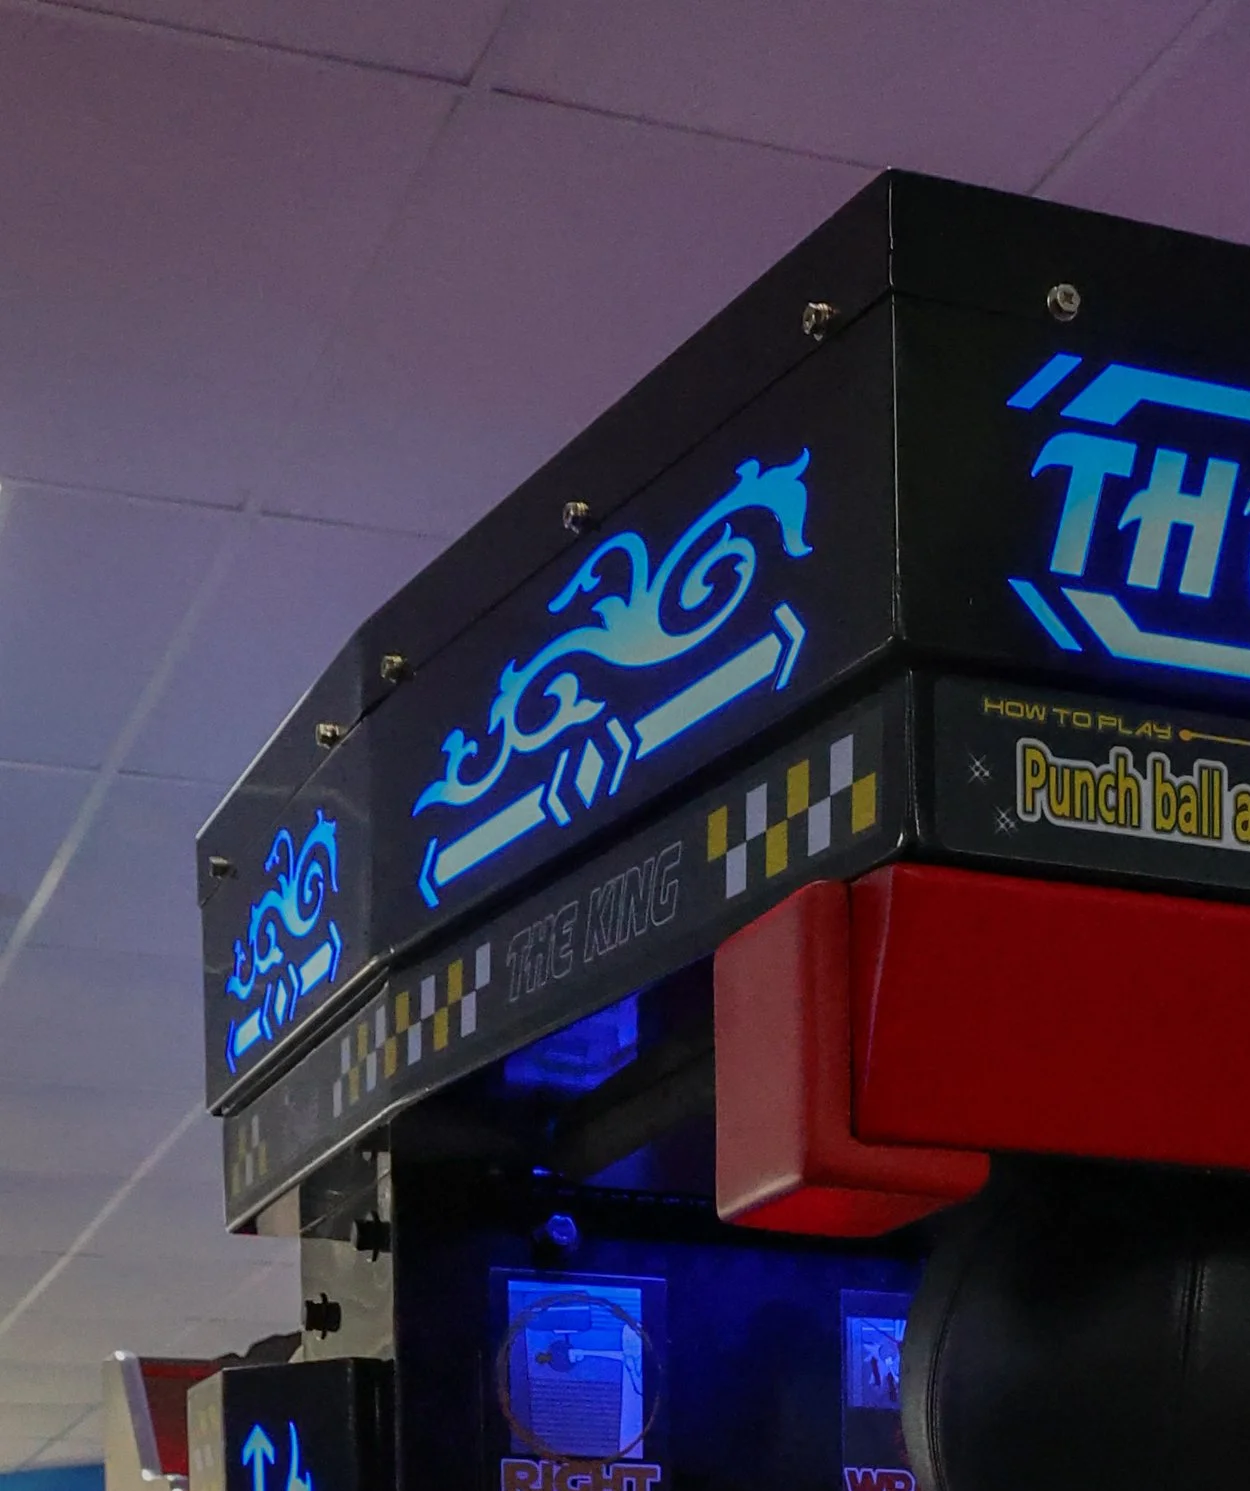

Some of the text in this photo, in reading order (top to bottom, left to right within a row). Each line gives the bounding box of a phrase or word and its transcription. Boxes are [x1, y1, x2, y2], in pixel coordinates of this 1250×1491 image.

[984, 698, 1173, 741] HOW TO PLAY
[1021, 745, 1142, 830] Punch
[1152, 756, 1222, 839] ball
[506, 841, 683, 1003] THE KING
